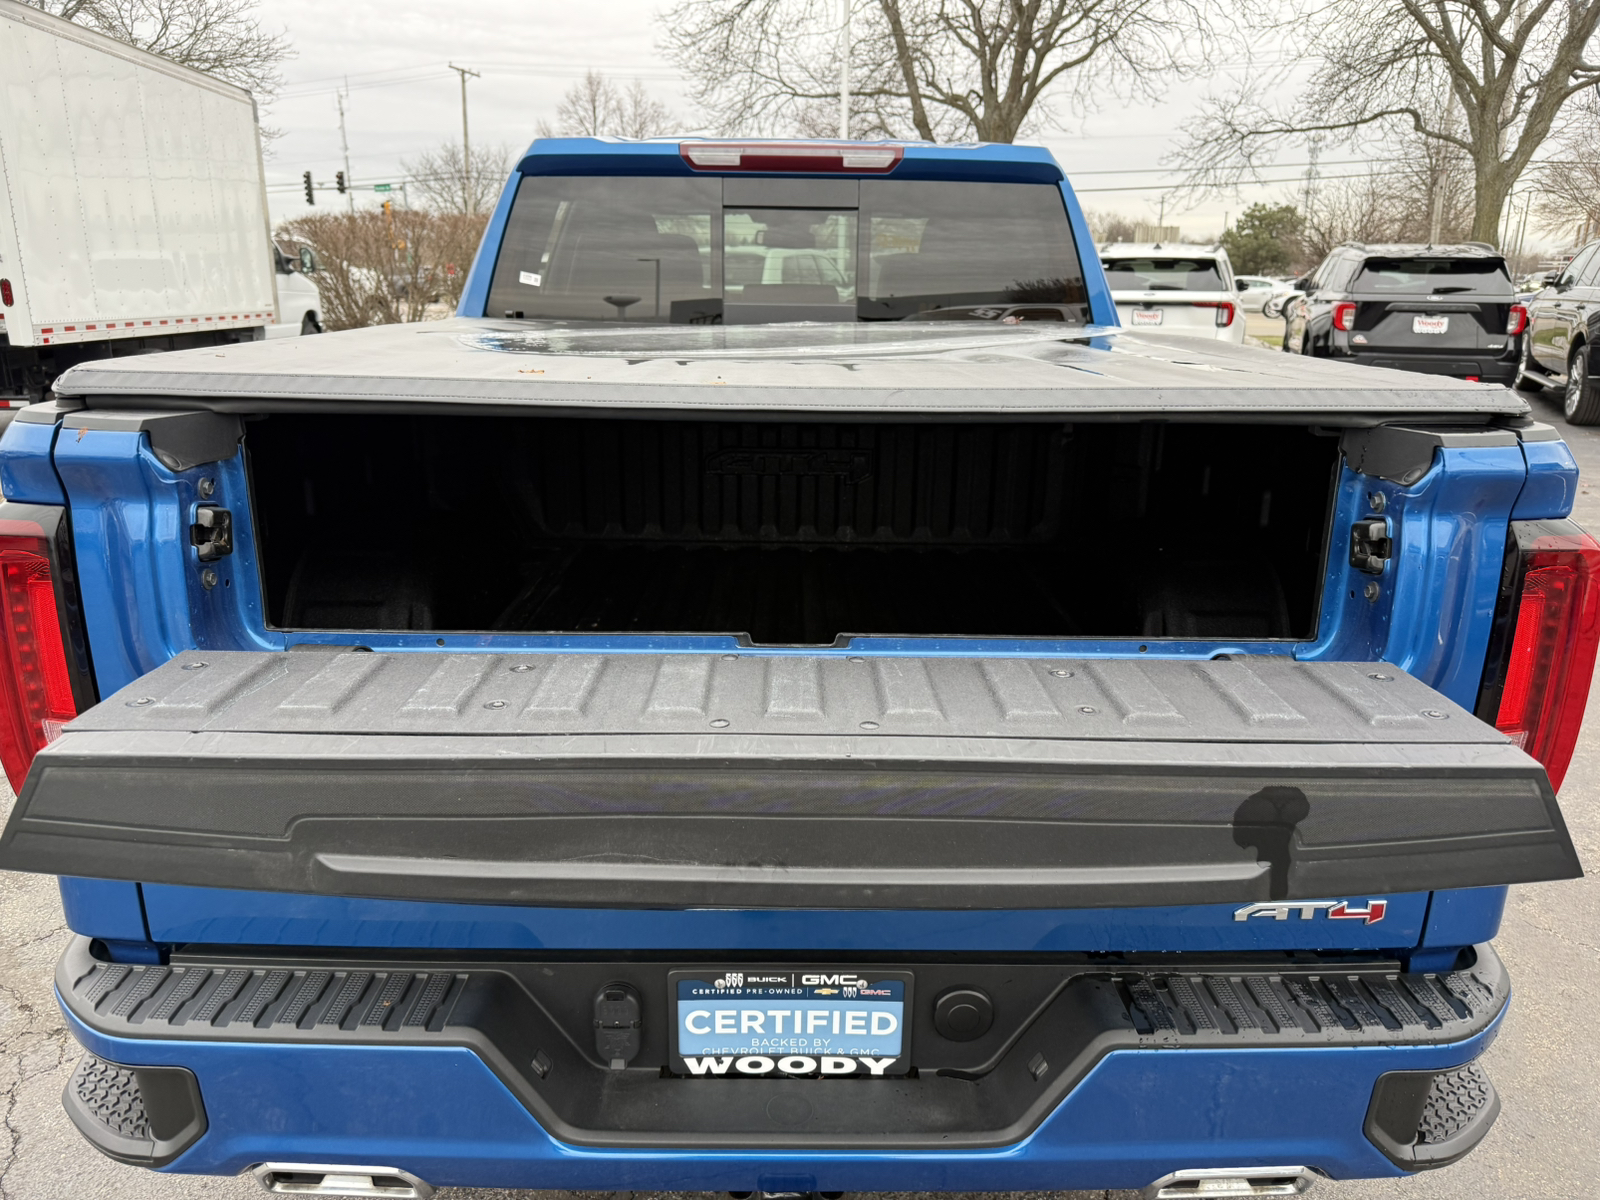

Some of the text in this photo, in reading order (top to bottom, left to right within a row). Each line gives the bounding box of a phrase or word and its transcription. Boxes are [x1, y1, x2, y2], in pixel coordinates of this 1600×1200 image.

[1234, 899, 1388, 924] AT4
[802, 974, 858, 985] GMC
[684, 1009, 898, 1036] CERTIFIED
[751, 1038, 831, 1047] BACKED BY
[683, 1056, 897, 1075] WOODY
